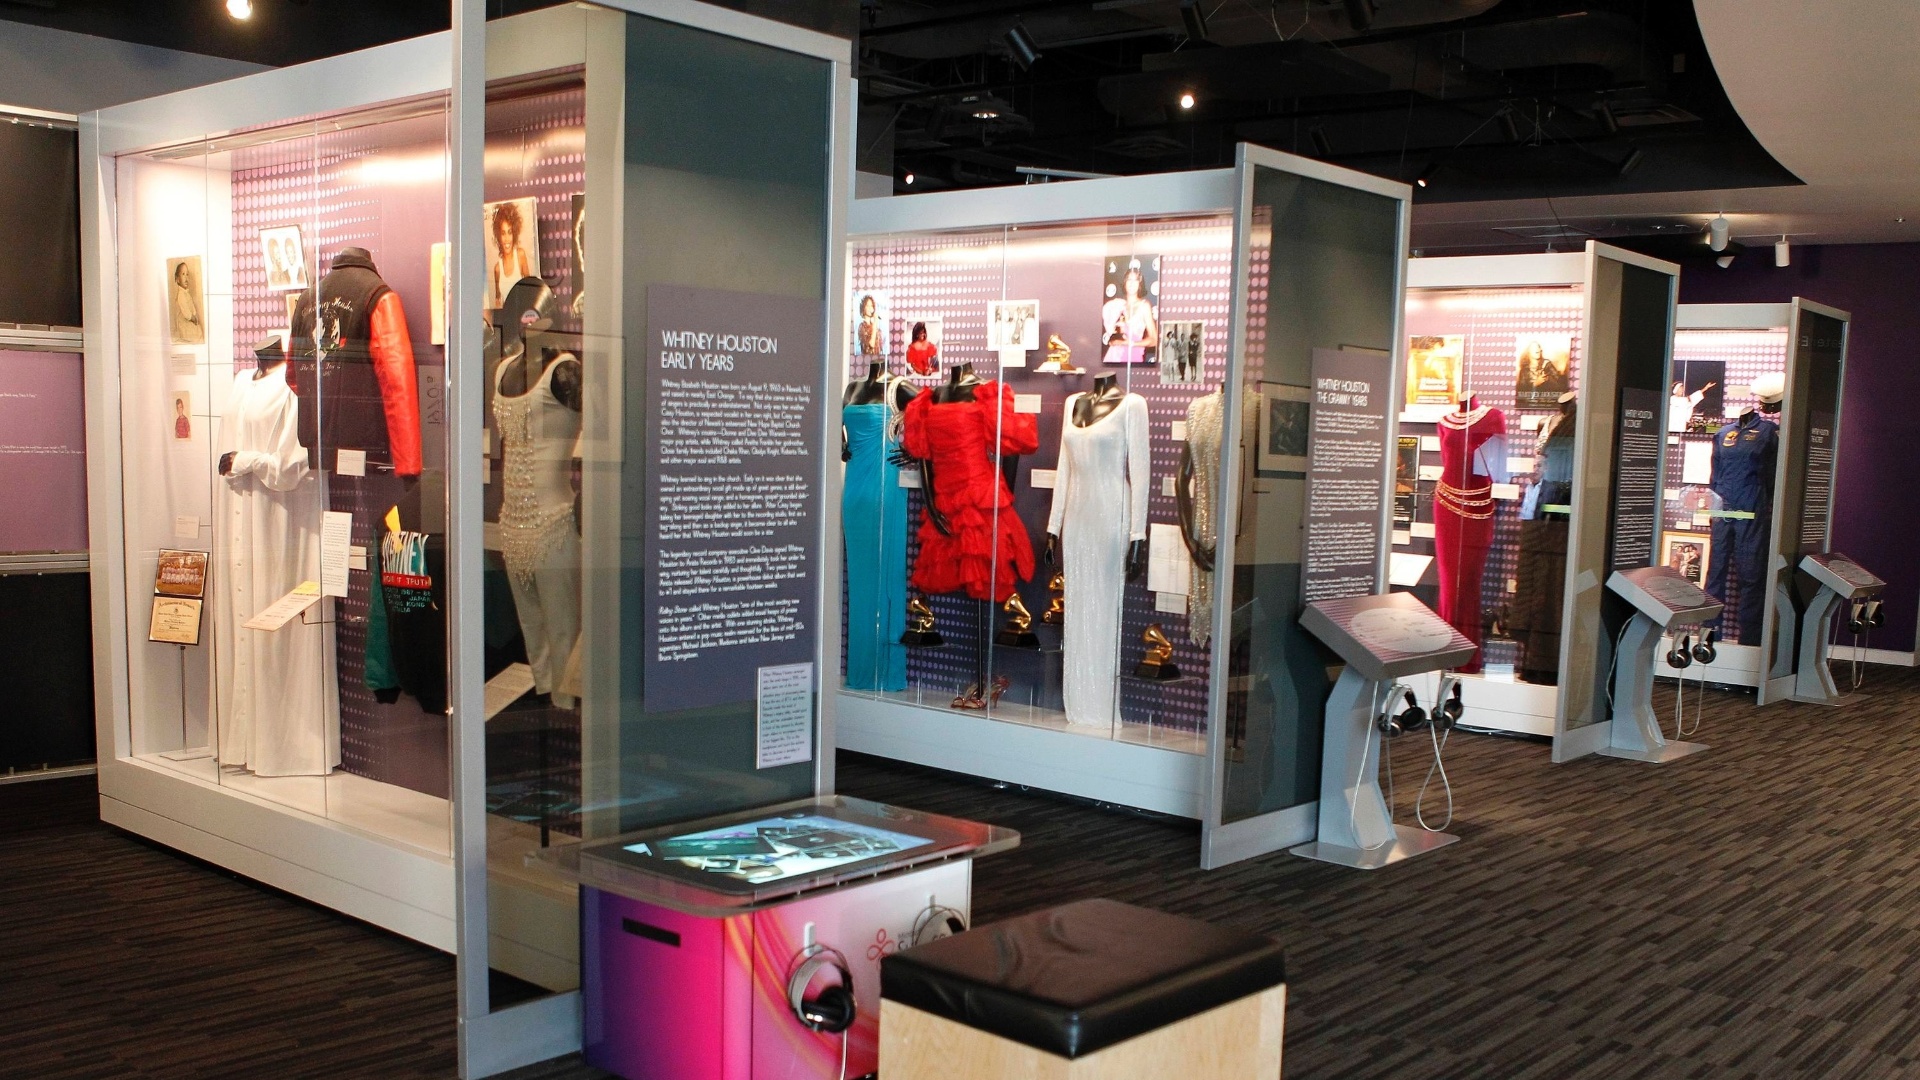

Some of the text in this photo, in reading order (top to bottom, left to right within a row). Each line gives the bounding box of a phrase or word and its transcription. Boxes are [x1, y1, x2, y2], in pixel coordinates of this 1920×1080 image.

[662, 330, 778, 354] WHITNEY HOUSTON
[661, 351, 734, 371] EARLY YEARS
[1317, 378, 1370, 394] WHITNEY HOUSTON
